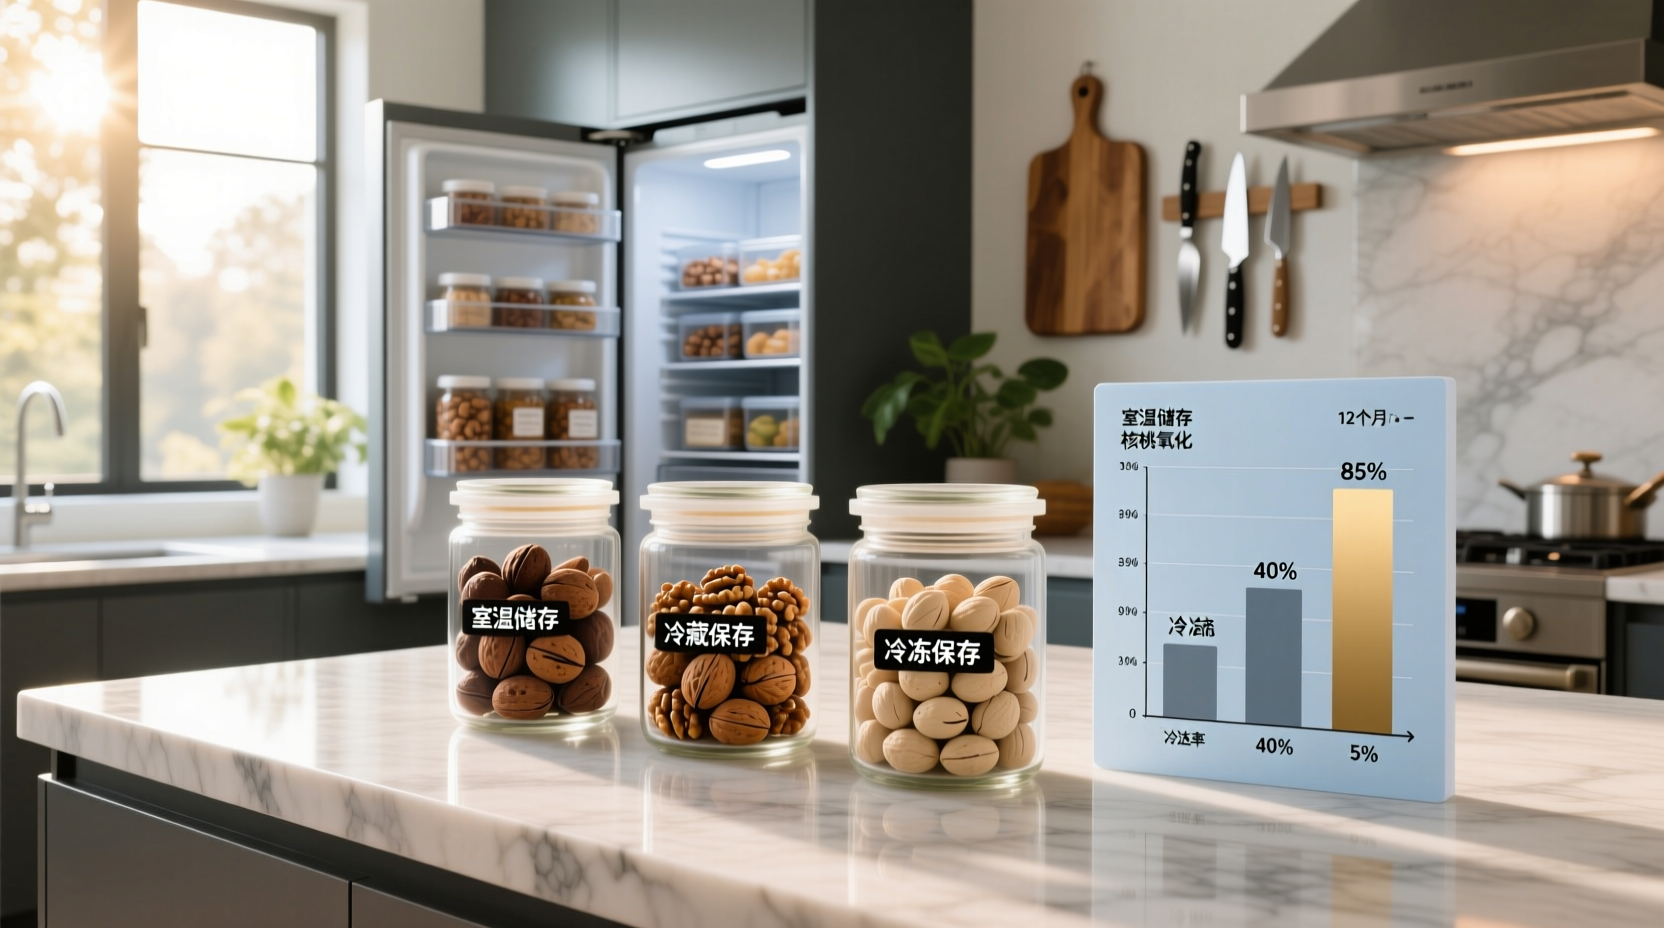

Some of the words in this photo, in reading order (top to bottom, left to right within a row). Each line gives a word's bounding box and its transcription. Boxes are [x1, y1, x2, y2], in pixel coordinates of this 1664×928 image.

[1340, 461, 1388, 481] 85%
[1253, 561, 1298, 581] 40%
[471, 605, 560, 631] 室温储存
[664, 620, 755, 649] 冷藏保存
[884, 637, 981, 666] 冷冻保存
[1128, 707, 1137, 719] 0
[1255, 737, 1294, 756] 40%
[1349, 743, 1379, 763] 5%
